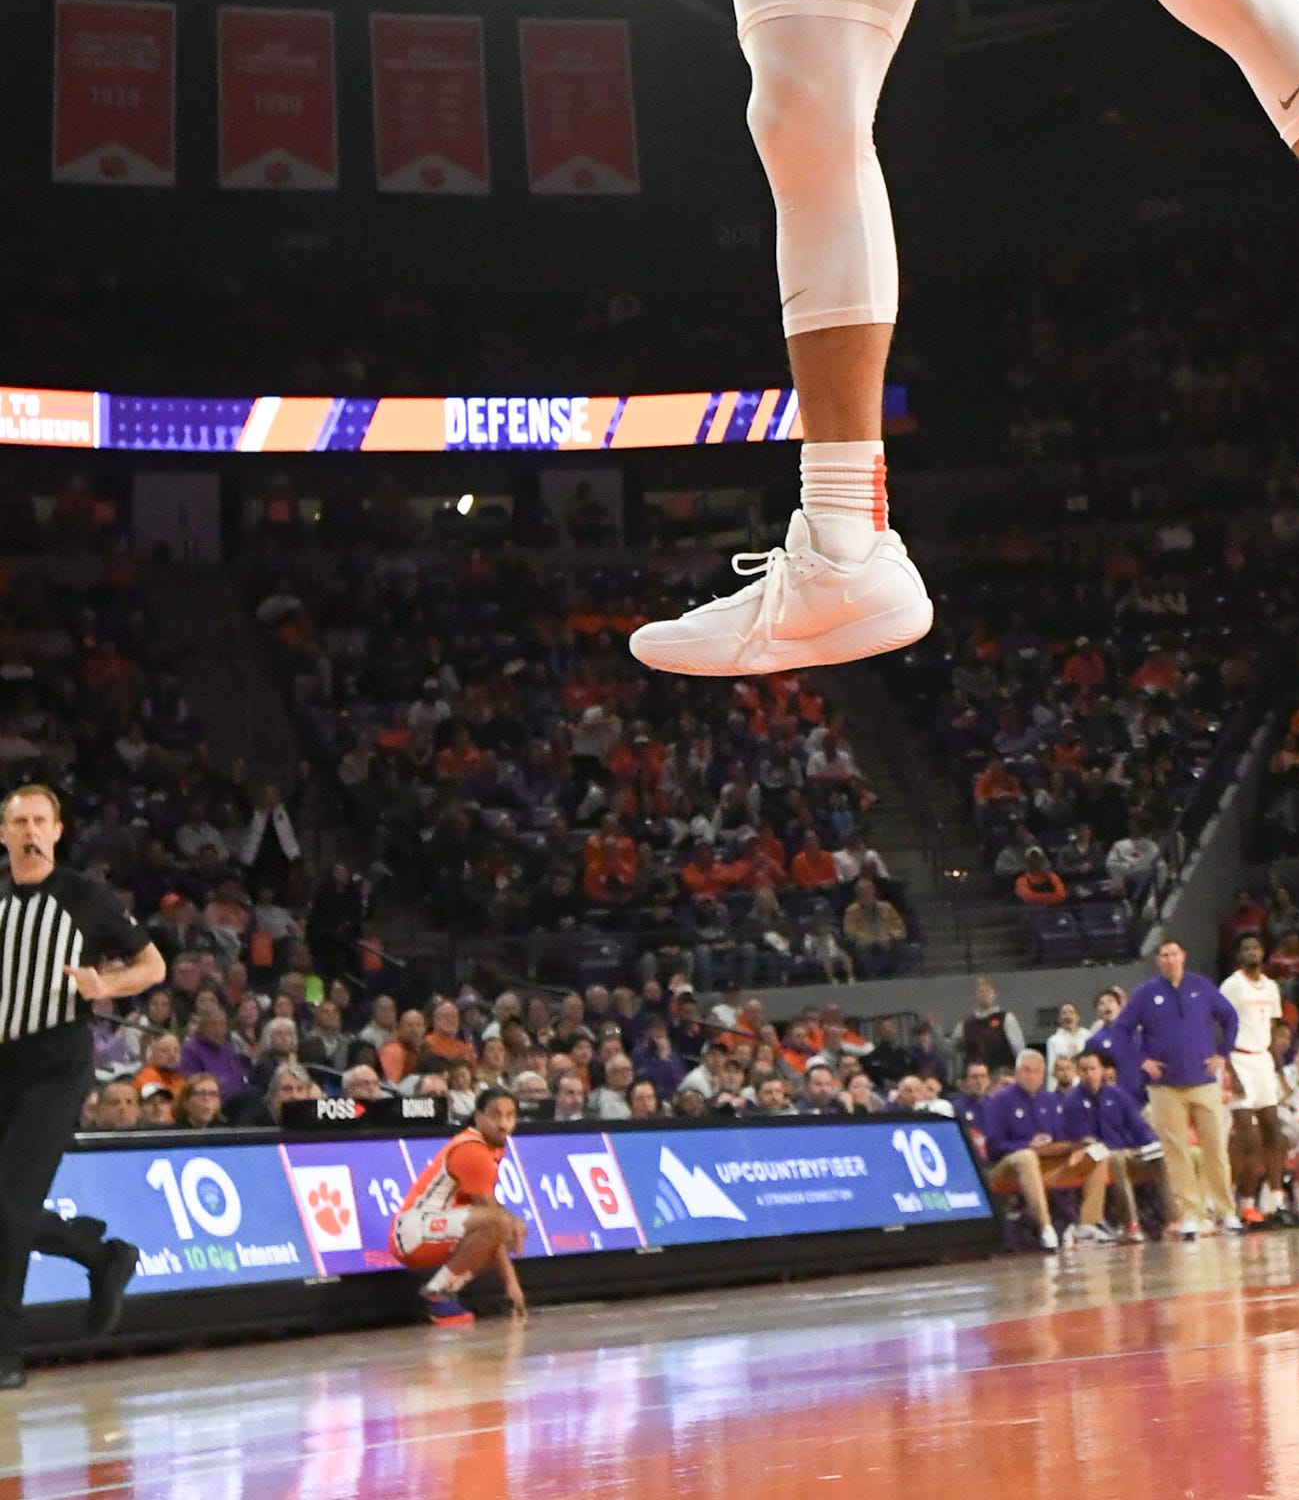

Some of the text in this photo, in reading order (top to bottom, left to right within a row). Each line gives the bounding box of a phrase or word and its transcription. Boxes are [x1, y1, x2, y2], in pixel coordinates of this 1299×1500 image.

[444, 396, 592, 444] DEFENSE
[316, 1097, 356, 1120] POSS
[714, 1156, 868, 1184] UPCOUNTRYFIBER
[892, 1128, 948, 1189] 10
[146, 1156, 242, 1240] 10
[368, 1177, 404, 1216] 13
[539, 1173, 574, 1210] 14
[589, 1166, 619, 1214] S
